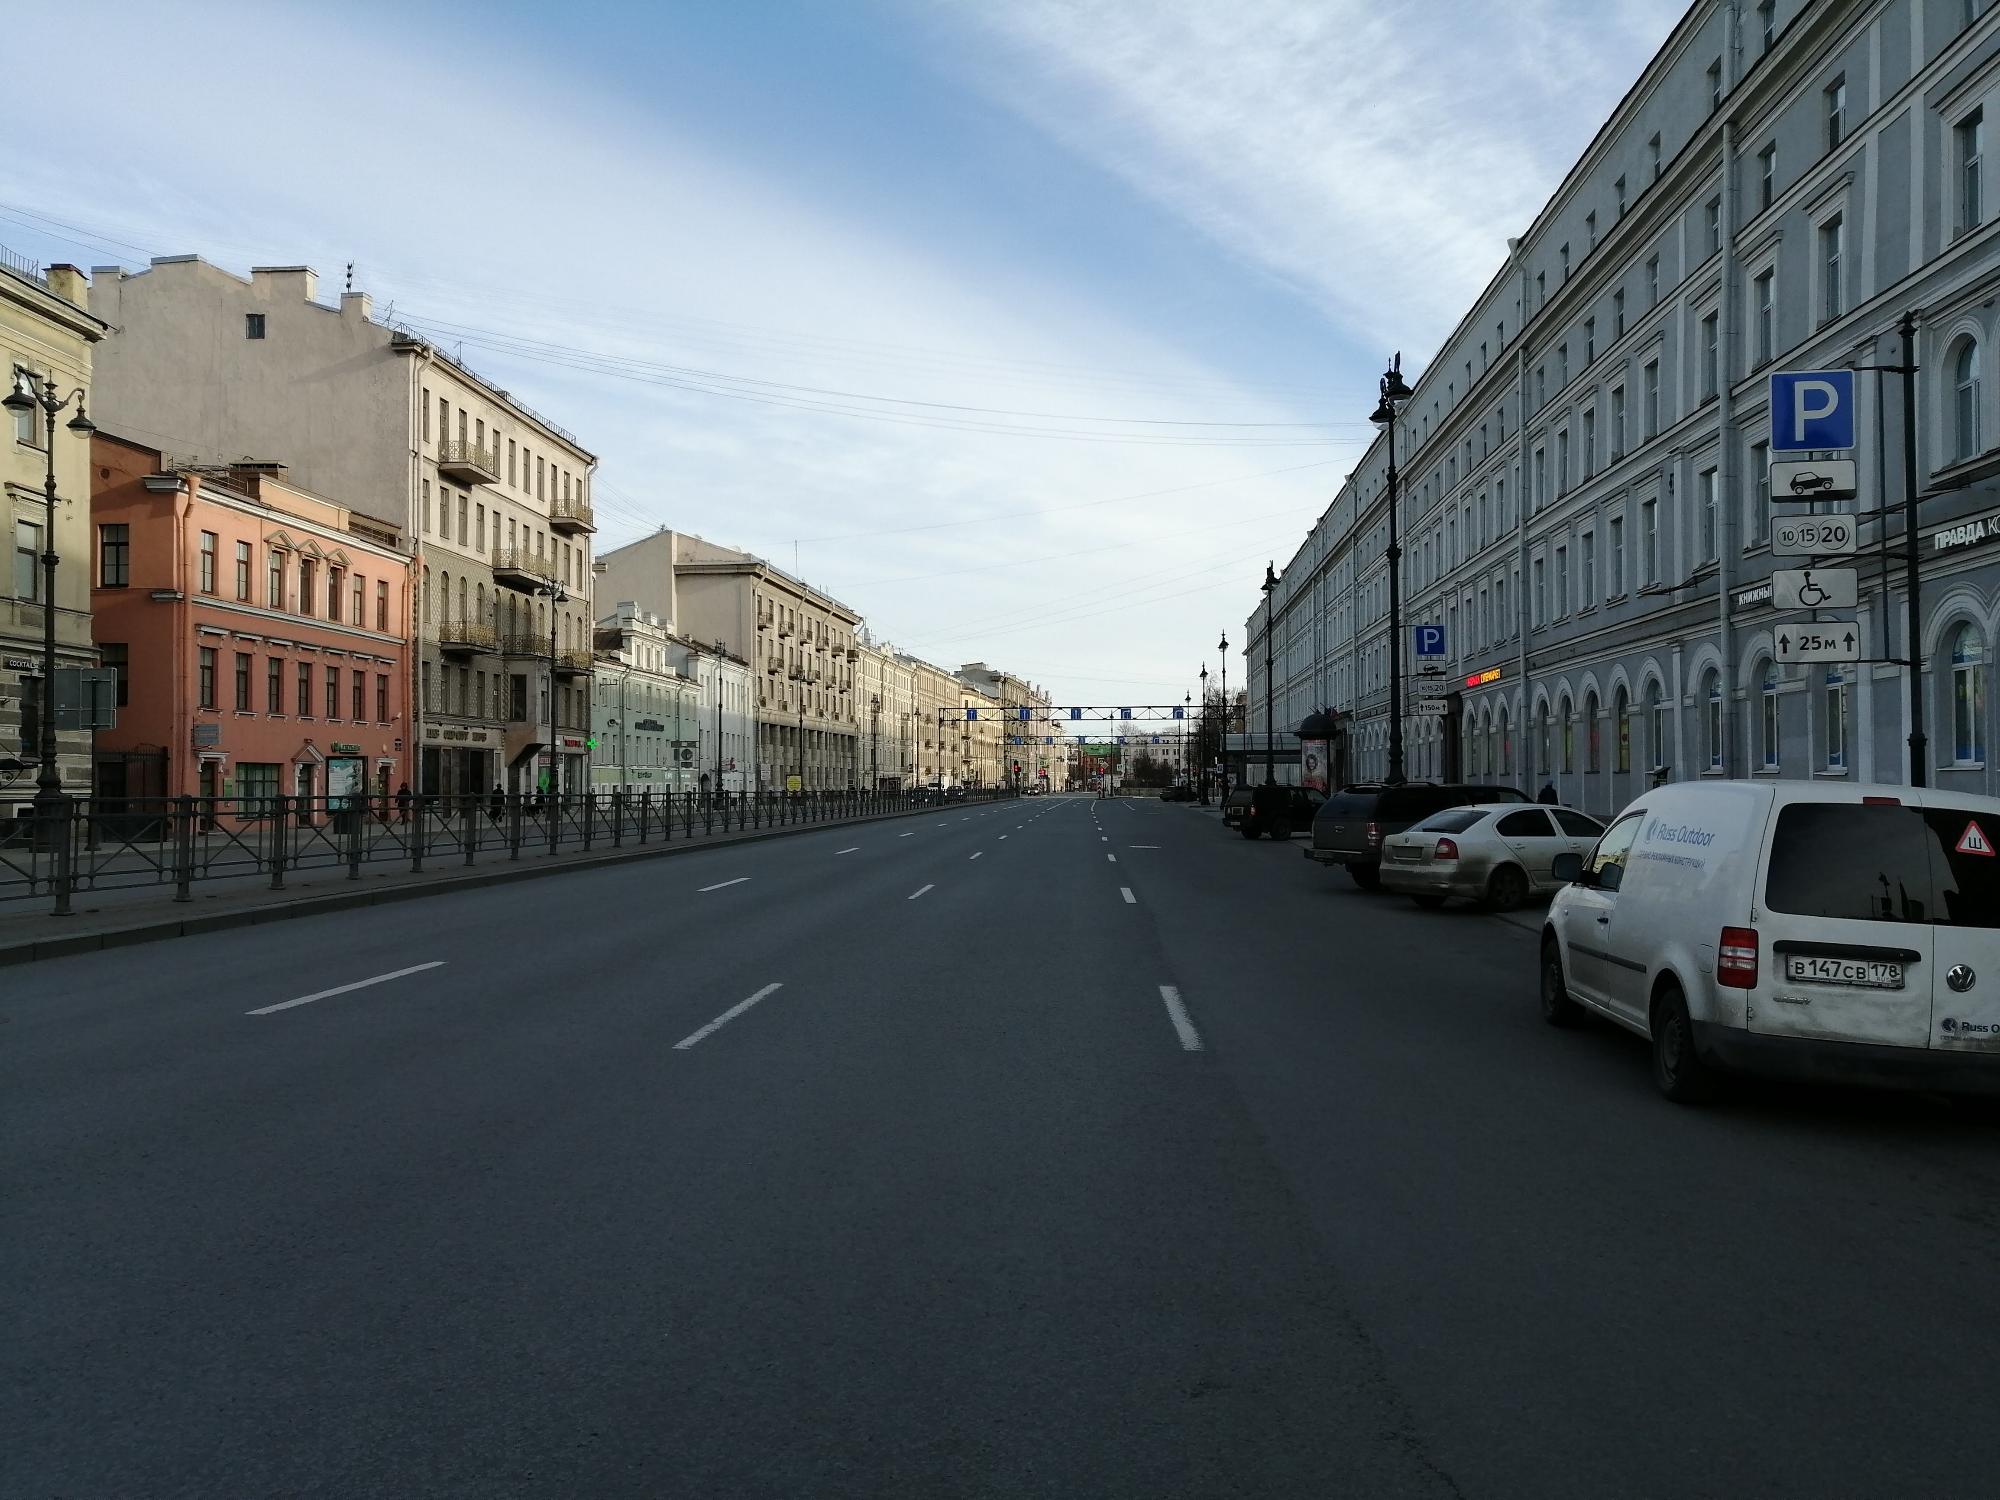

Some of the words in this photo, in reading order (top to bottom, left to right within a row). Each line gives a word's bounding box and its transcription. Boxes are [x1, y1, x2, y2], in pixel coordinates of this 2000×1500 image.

[1794, 380, 1839, 442] P
[1781, 530, 1795, 542] 10
[1799, 528, 1816, 543] 15
[1821, 525, 1846, 543] 20
[1934, 521, 1986, 550] ПРАВДА
[1738, 585, 1772, 606] КНИЖНЫ
[1423, 628, 1440, 652] P
[1657, 823, 1678, 842] Russ
[1677, 825, 1716, 846] Outdoor
[1968, 836, 1982, 850] Ш
[1870, 963, 1897, 978] 178
[1961, 1021, 1989, 1033] Russ
